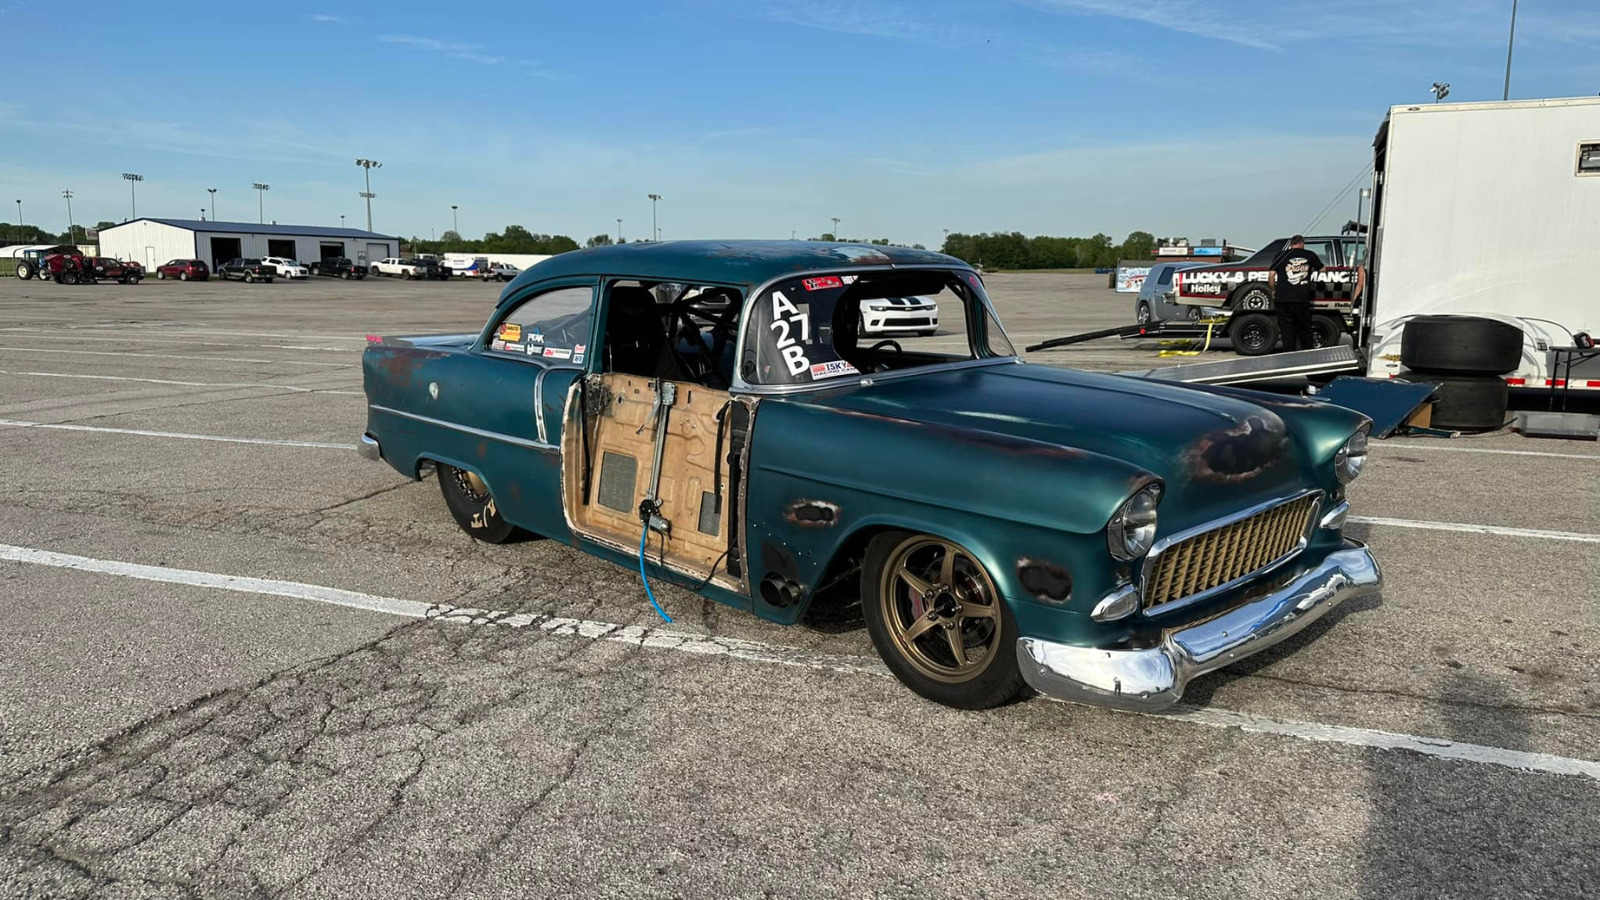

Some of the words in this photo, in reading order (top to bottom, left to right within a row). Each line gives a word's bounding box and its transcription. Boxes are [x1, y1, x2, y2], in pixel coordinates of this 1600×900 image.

[1191, 284, 1221, 295] Holley
[527, 333, 545, 344] PEAK
[825, 361, 847, 371] ISKY
